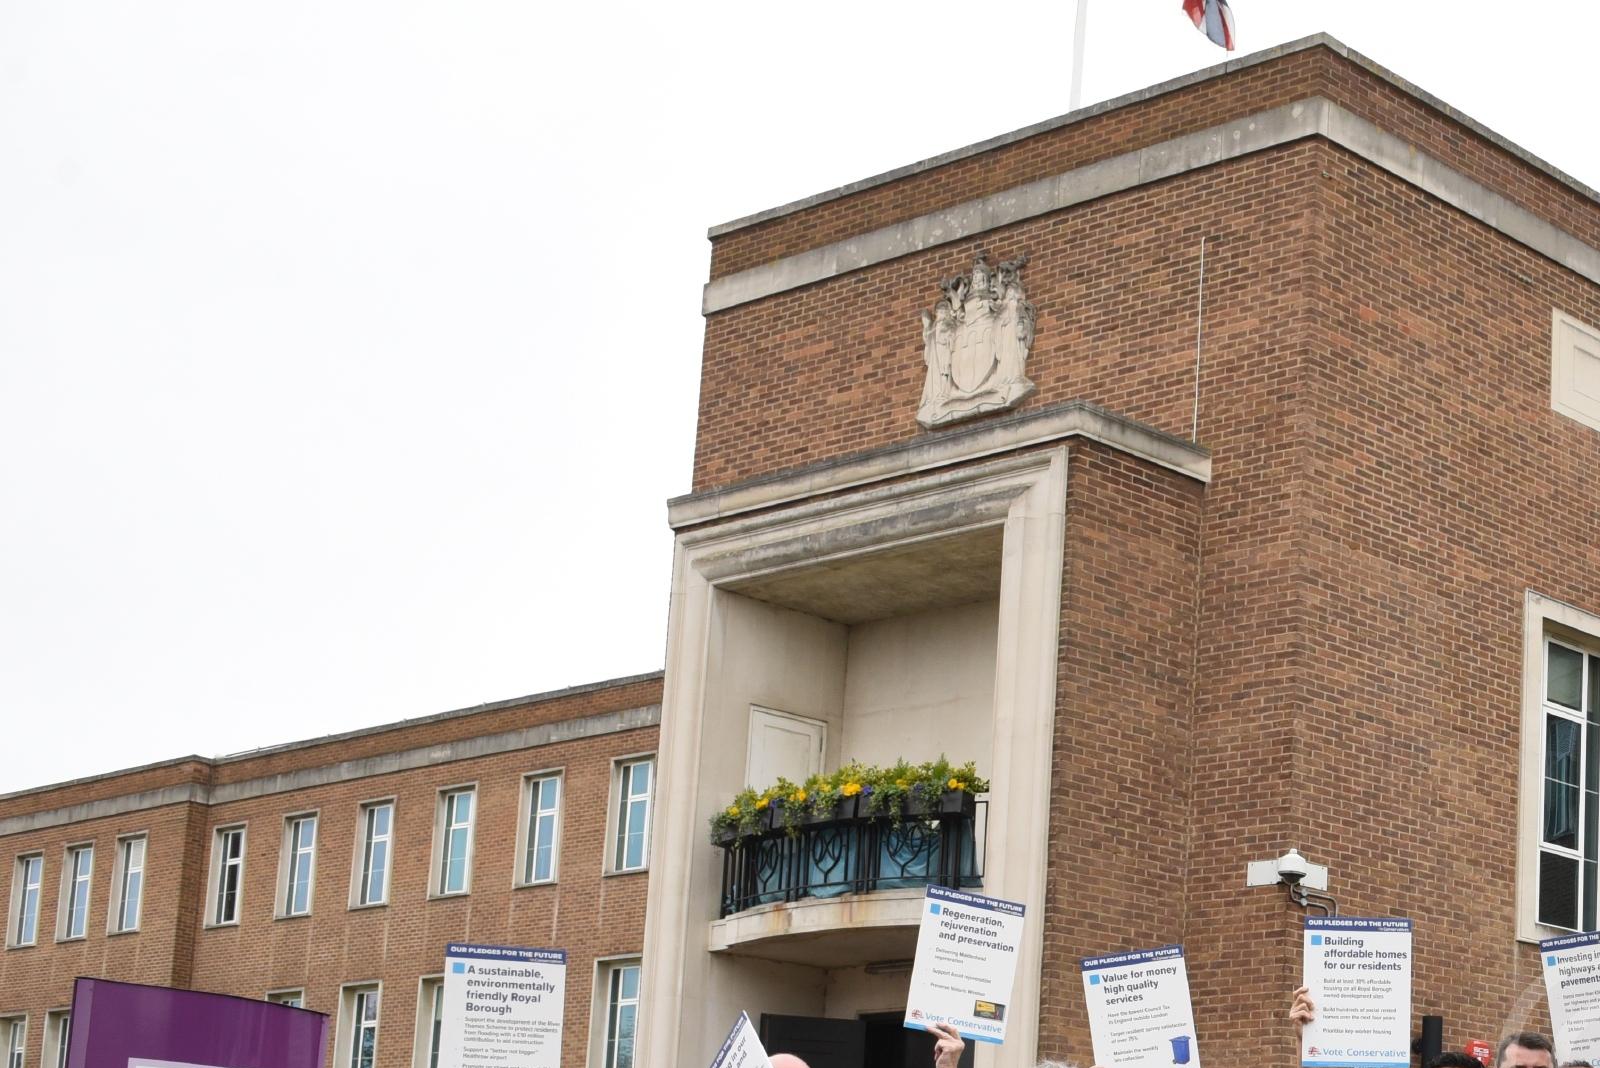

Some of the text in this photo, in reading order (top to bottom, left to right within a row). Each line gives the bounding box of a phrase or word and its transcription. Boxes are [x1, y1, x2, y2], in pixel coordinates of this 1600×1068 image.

[942, 907, 1004, 928] Regeneration,
[940, 919, 997, 937] rejuvenation
[939, 931, 1014, 952] and preservation
[1324, 937, 1363, 947] Building
[1324, 950, 1407, 959] affordable homes
[1557, 952, 1592, 964] Investing
[1594, 949, 1600, 958] in
[468, 965, 544, 979] A sustainable,
[1324, 961, 1401, 970] for our residents
[1559, 963, 1595, 976] highways
[1102, 966, 1177, 983] Value for money
[467, 978, 555, 993] environmentally
[1104, 980, 1159, 995] high quality
[466, 990, 540, 1004] friendly Royal
[1106, 993, 1143, 1005] services
[466, 1003, 512, 1015] Borough
